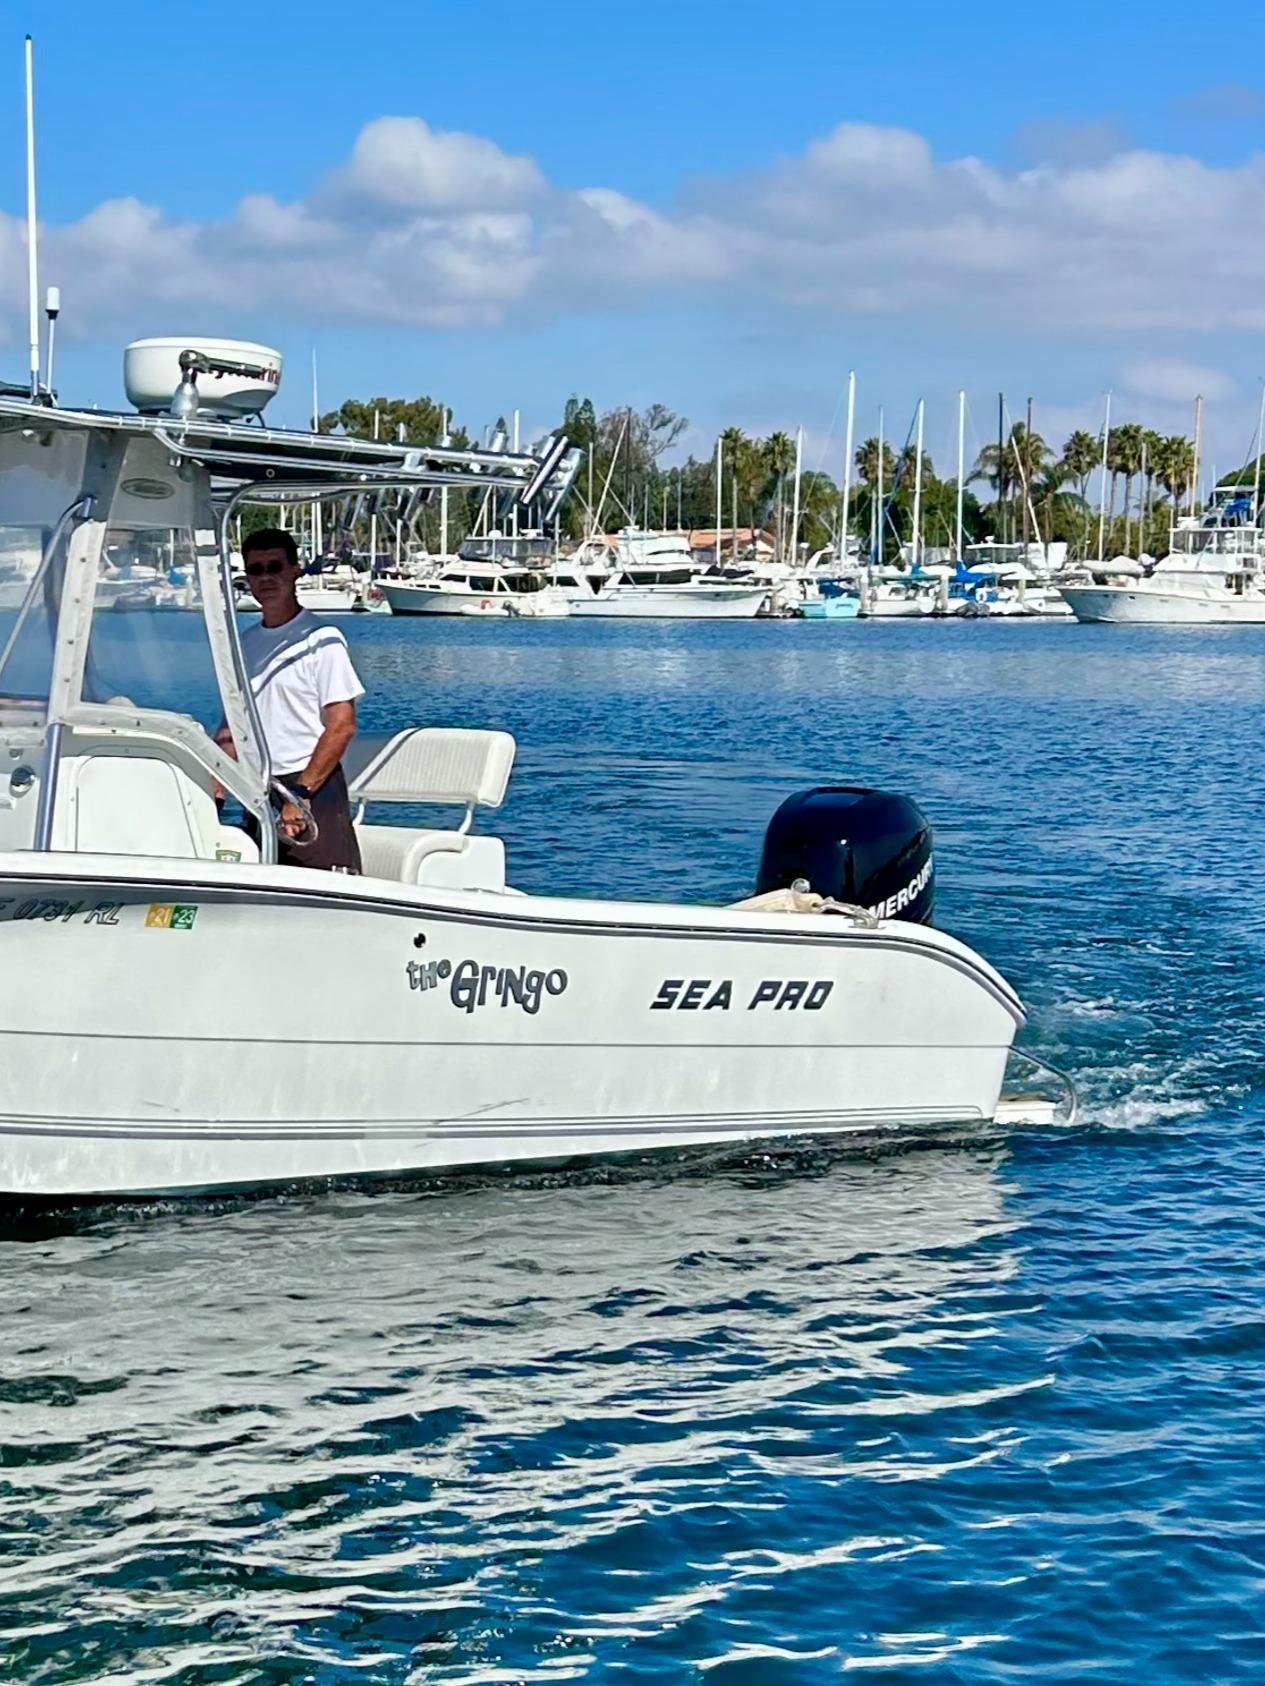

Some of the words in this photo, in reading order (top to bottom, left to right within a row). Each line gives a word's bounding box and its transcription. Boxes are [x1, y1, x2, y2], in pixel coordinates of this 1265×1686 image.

[83, 901, 125, 926] RL
[177, 909, 195, 924] 23
[649, 980, 732, 1010] SEA
[746, 980, 834, 1010] PRO
